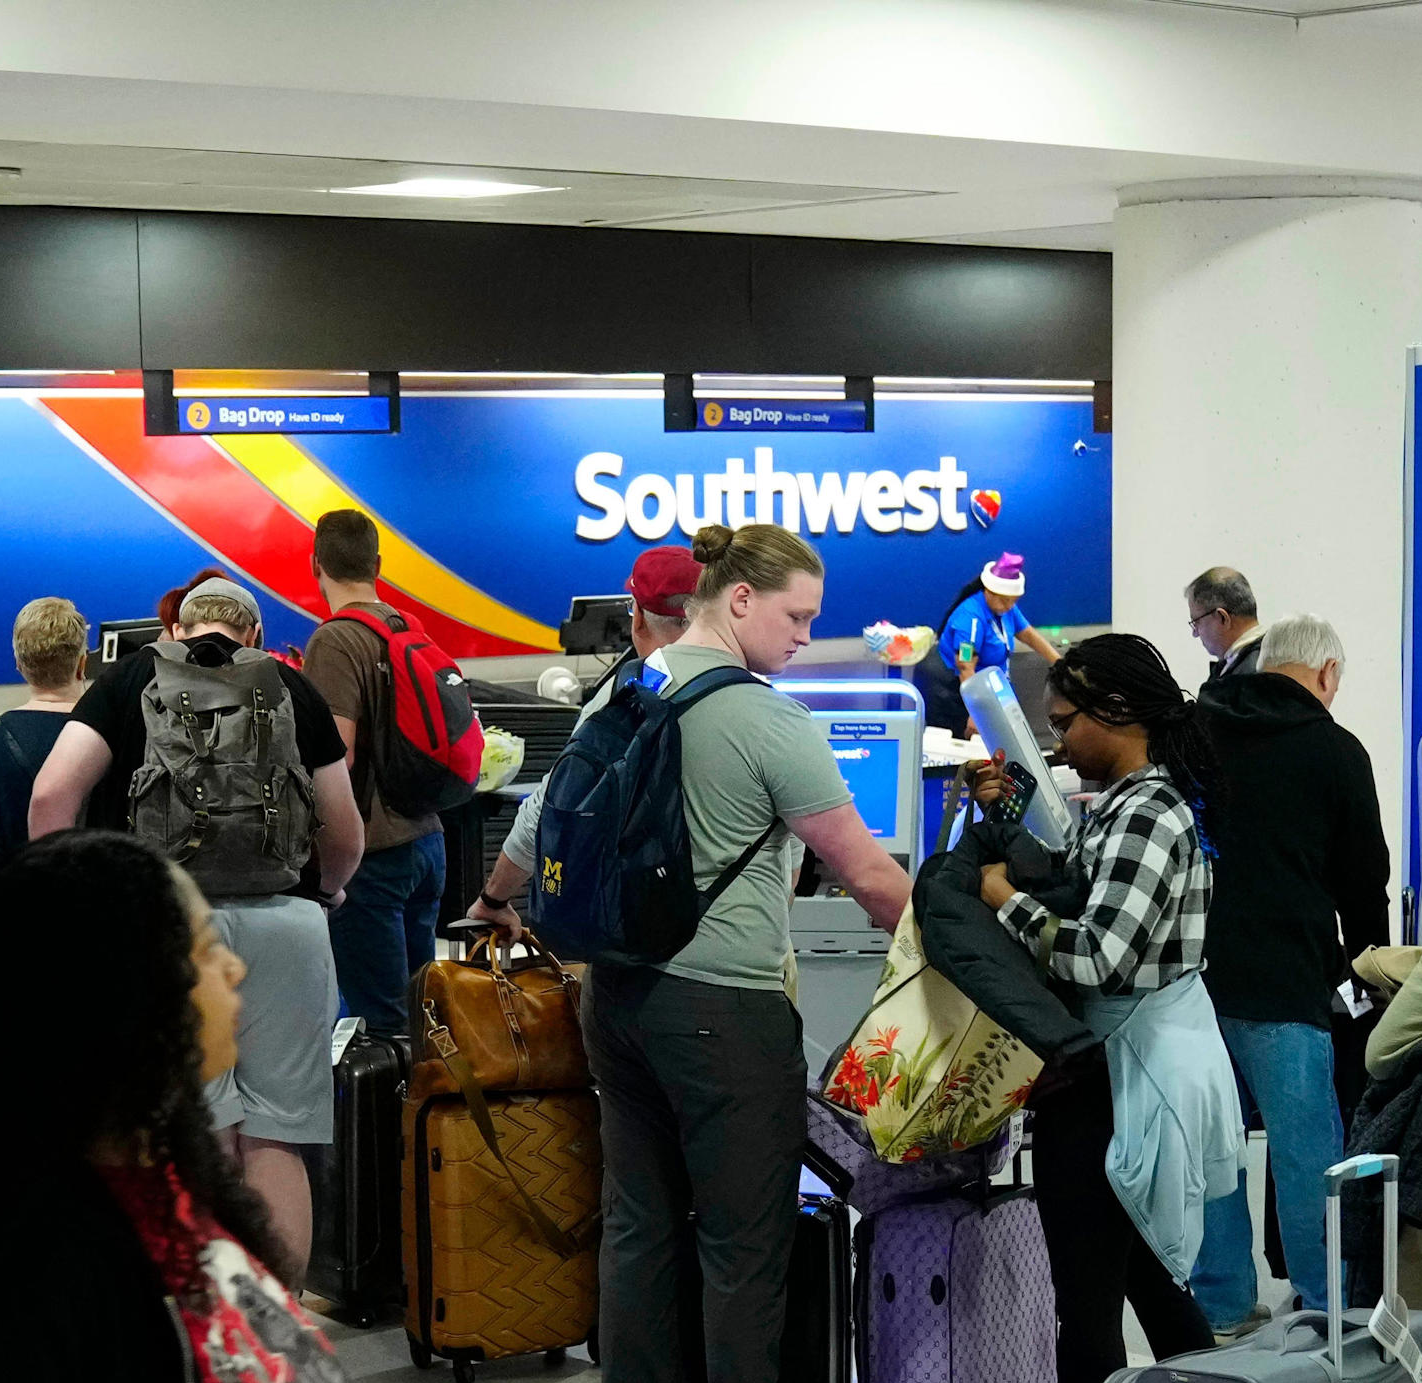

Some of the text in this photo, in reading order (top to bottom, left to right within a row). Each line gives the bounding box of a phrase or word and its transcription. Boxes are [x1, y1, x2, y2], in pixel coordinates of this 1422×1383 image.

[218, 406, 247, 427] Bag
[248, 406, 286, 427] Drop
[289, 412, 310, 422] Have
[311, 412, 321, 422] ID
[322, 411, 345, 424] ready
[729, 407, 752, 426] Bag
[753, 407, 783, 425] Drop
[574, 446, 969, 541] Southwest
[543, 856, 563, 881] M
